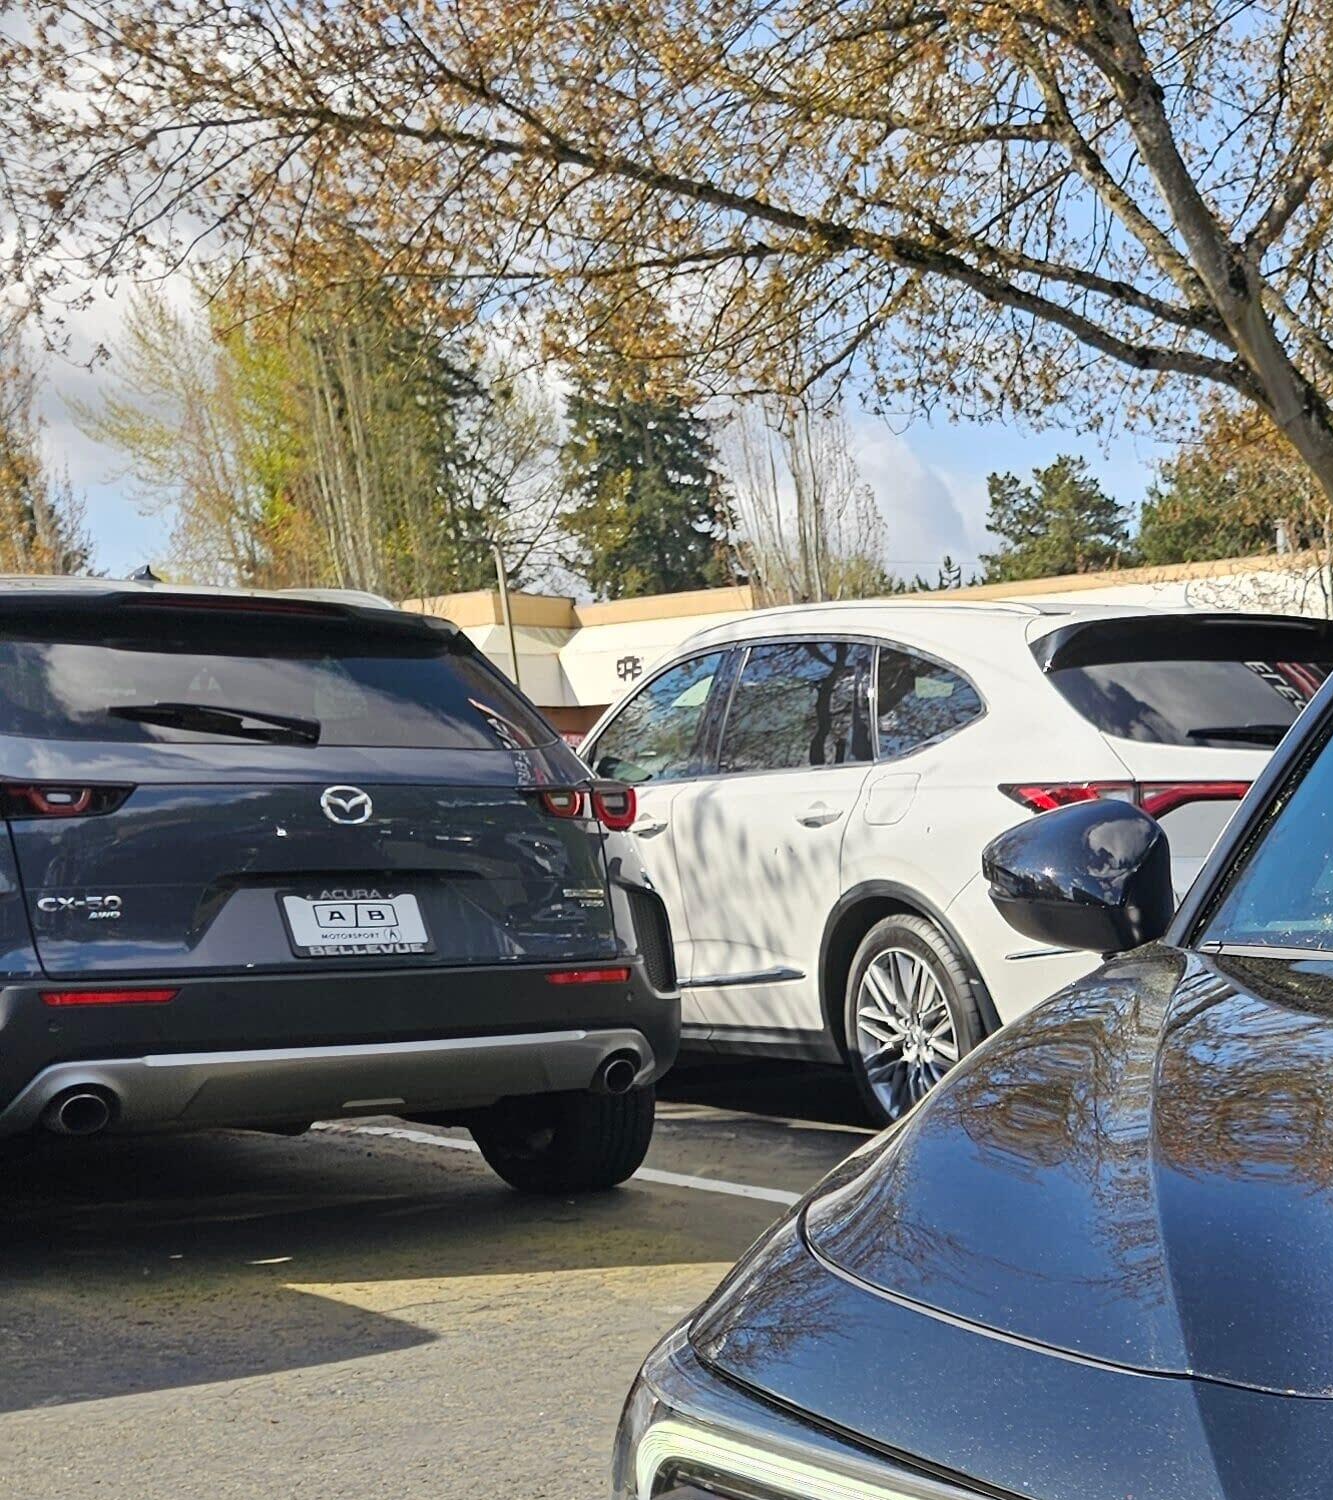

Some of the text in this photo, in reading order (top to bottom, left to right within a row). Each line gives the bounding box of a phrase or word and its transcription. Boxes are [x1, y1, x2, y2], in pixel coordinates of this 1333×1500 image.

[320, 889, 382, 901] ACURA
[37, 895, 122, 912] CX-50
[88, 911, 121, 920] AWD
[308, 943, 425, 956] BELLEVUE
